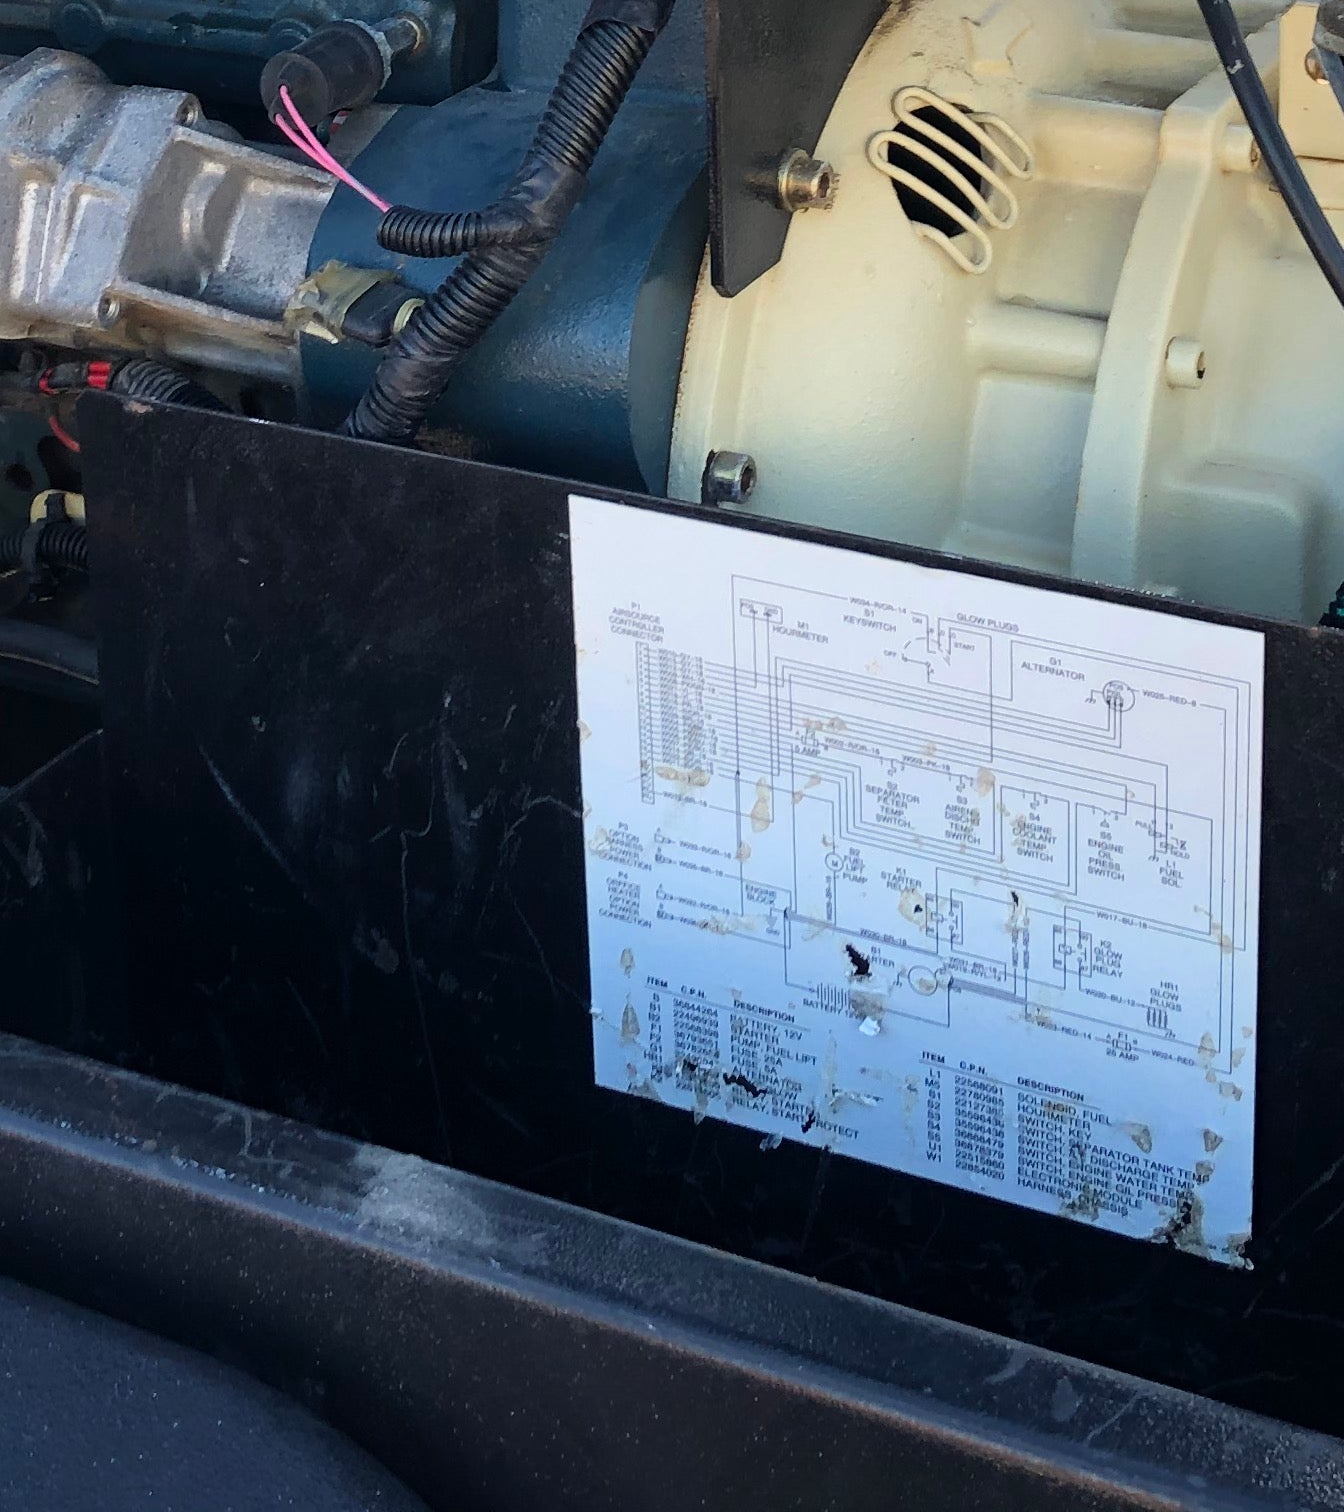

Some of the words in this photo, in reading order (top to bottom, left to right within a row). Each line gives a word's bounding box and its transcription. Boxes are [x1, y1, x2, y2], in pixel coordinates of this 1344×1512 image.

[609, 615, 665, 635] CONTROLLER
[842, 614, 897, 633] KEYSWITCH
[956, 612, 985, 626] GLOW
[987, 618, 1020, 633] PLUGS
[610, 624, 664, 643] CONNECTOR
[773, 625, 829, 644] HOURMETER
[1020, 661, 1086, 682] ALTERNATOR
[865, 784, 921, 805] SEPARATOR
[877, 794, 908, 810] FILTER
[875, 813, 911, 829] SWITCH
[945, 829, 981, 845] SWITCH
[1016, 847, 1054, 863] SWITCH
[1087, 838, 1124, 855] ENGINE
[842, 872, 868, 885] PUMP
[880, 871, 922, 888] STARTER
[1087, 866, 1125, 882] SWITCH
[1159, 866, 1184, 880] FUEL
[1094, 946, 1123, 960] GLOW
[1092, 963, 1124, 978] RELAY
[1095, 955, 1121, 969] PLUG
[646, 975, 669, 988] ITEM
[1150, 987, 1179, 1002] GLOW
[733, 999, 796, 1023] DESCRIPTION
[1149, 996, 1182, 1012] PLUGS
[922, 1049, 945, 1064] ITEM
[1017, 1076, 1085, 1102] DESCRIPTION
[1017, 1104, 1091, 1131] HOURMETER
[1083, 1110, 1113, 1127] FUEL
[1068, 1128, 1092, 1141] KEY
[1089, 1155, 1160, 1183] DISCHARGE
[1144, 1158, 1174, 1175] TANK
[926, 1150, 942, 1163] W1
[1093, 1188, 1143, 1210] MODULE
[1115, 1172, 1158, 1191] WATER
